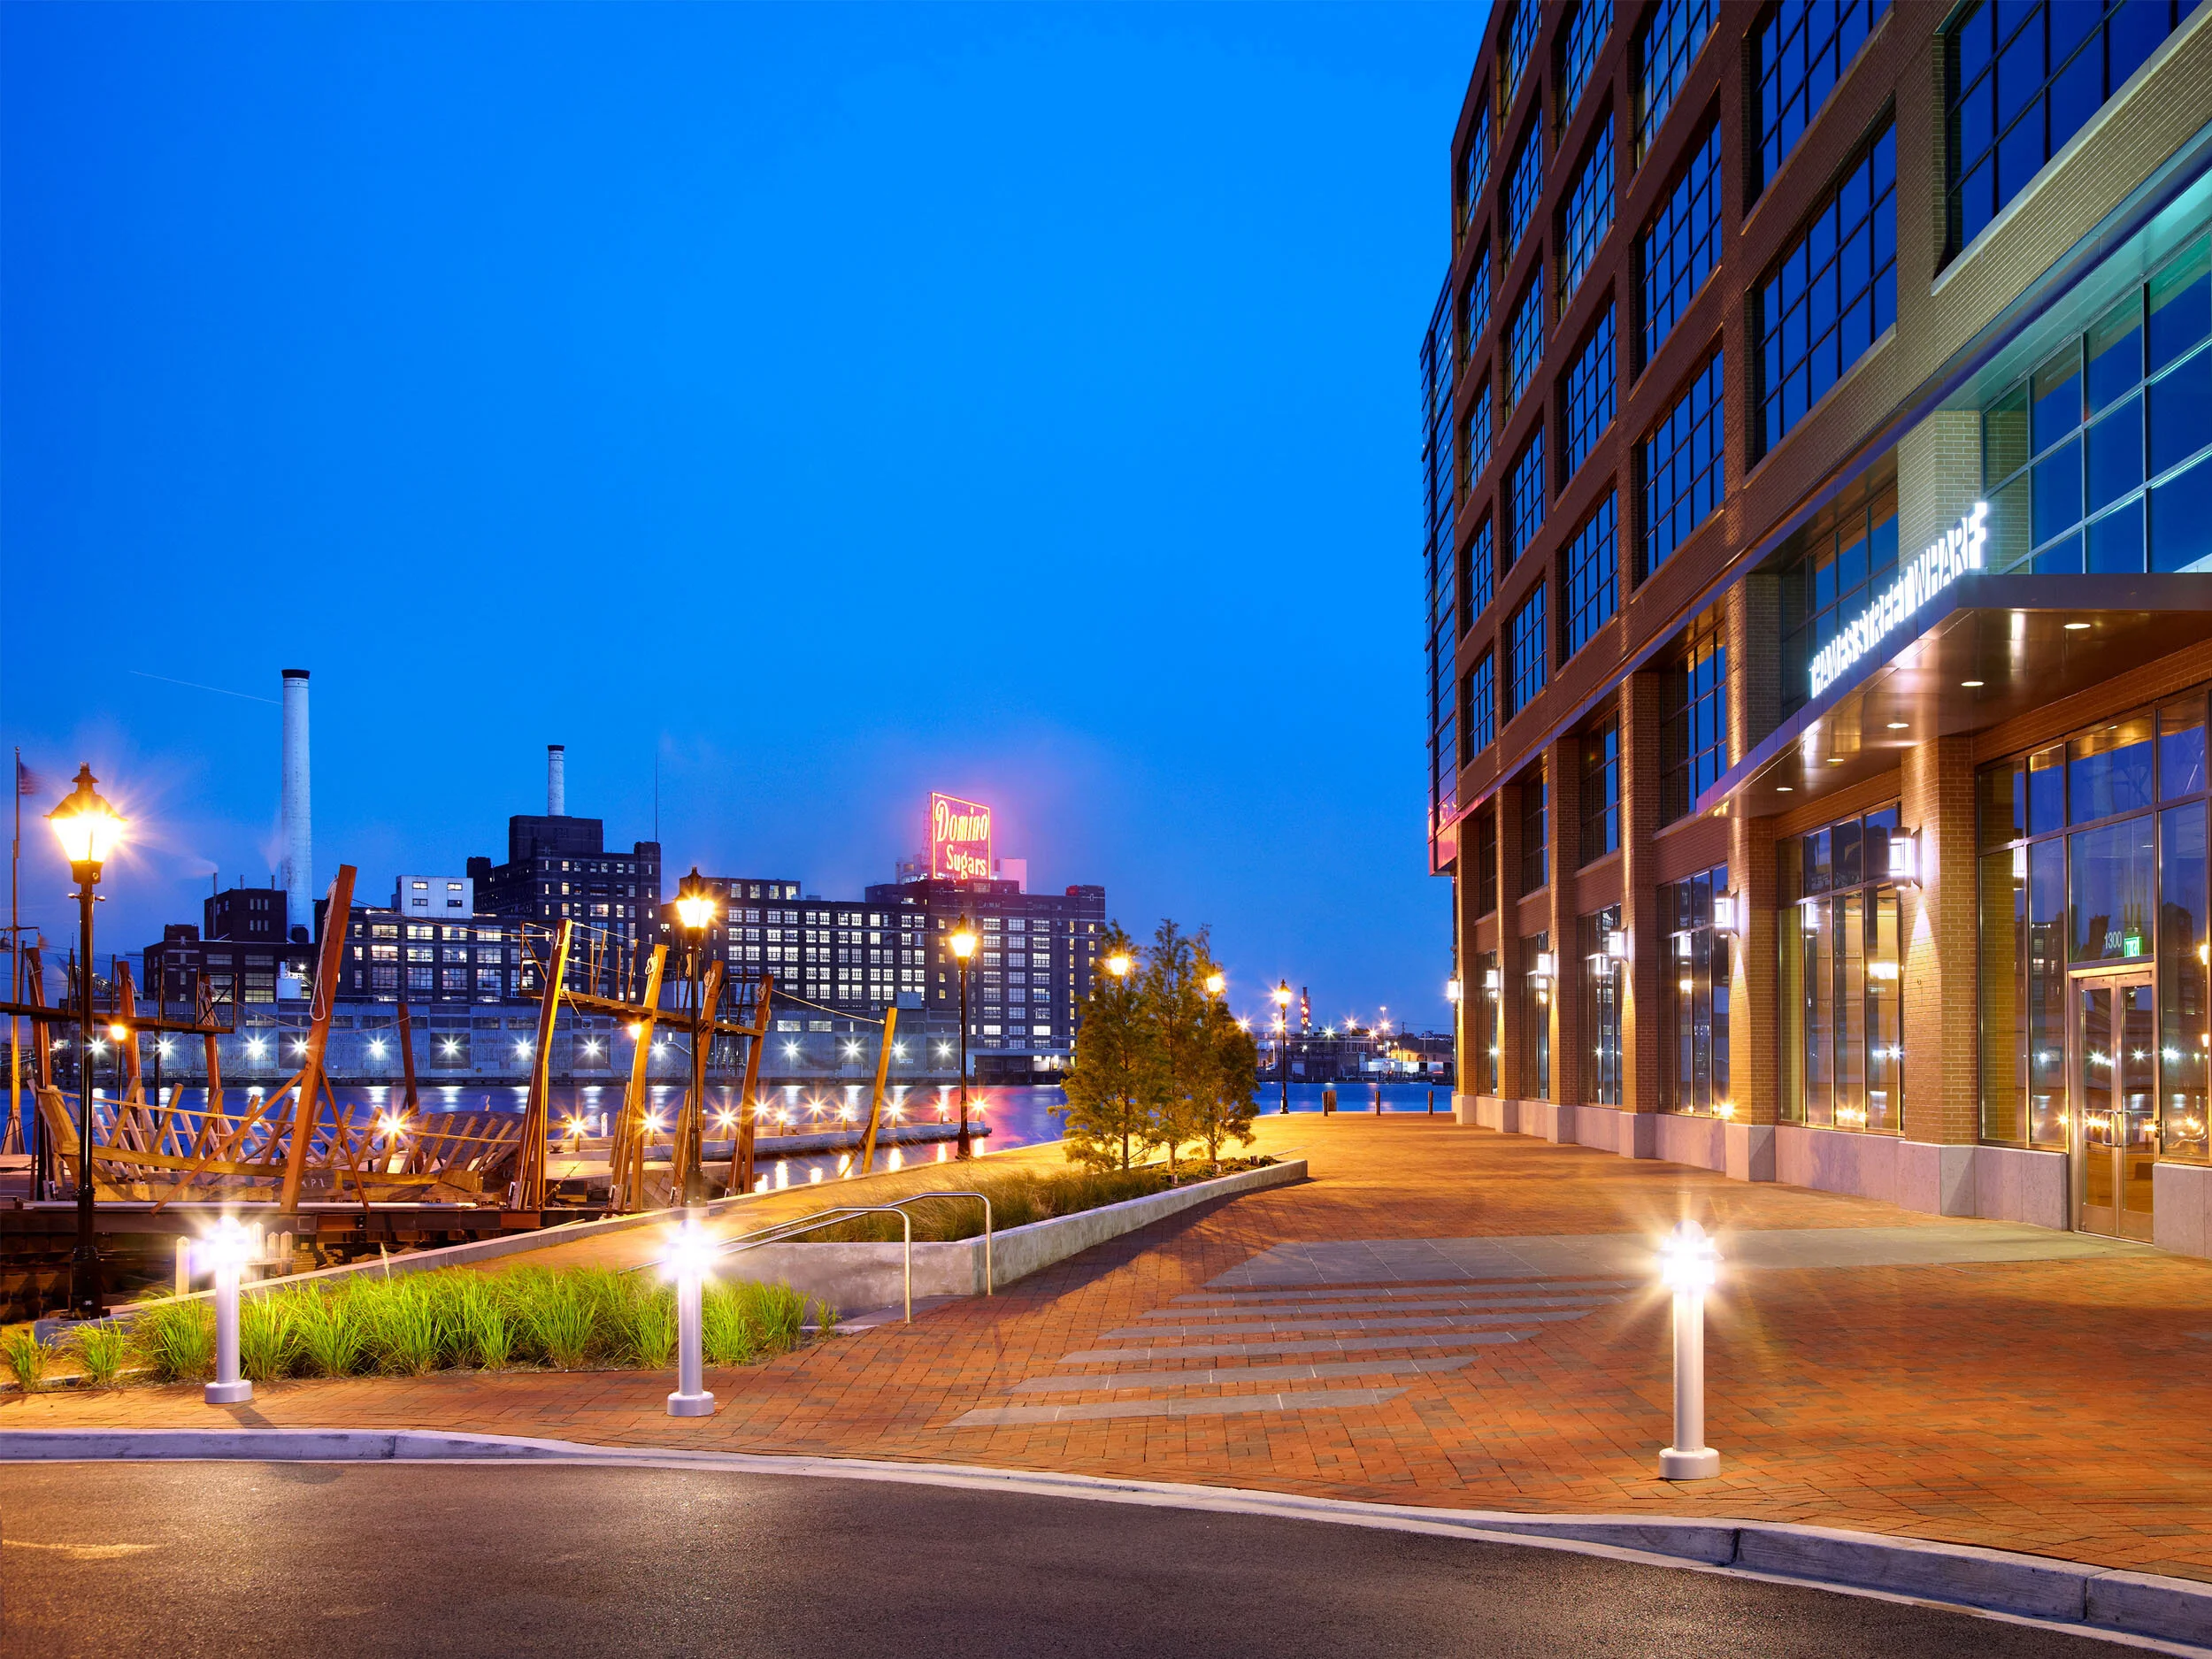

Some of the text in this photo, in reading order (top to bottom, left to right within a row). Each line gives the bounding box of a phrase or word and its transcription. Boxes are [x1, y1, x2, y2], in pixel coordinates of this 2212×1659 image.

[1908, 503, 1987, 614] WHARF
[935, 800, 988, 842] Domino
[946, 844, 987, 879] Sugars
[2104, 931, 2123, 949] 1300
